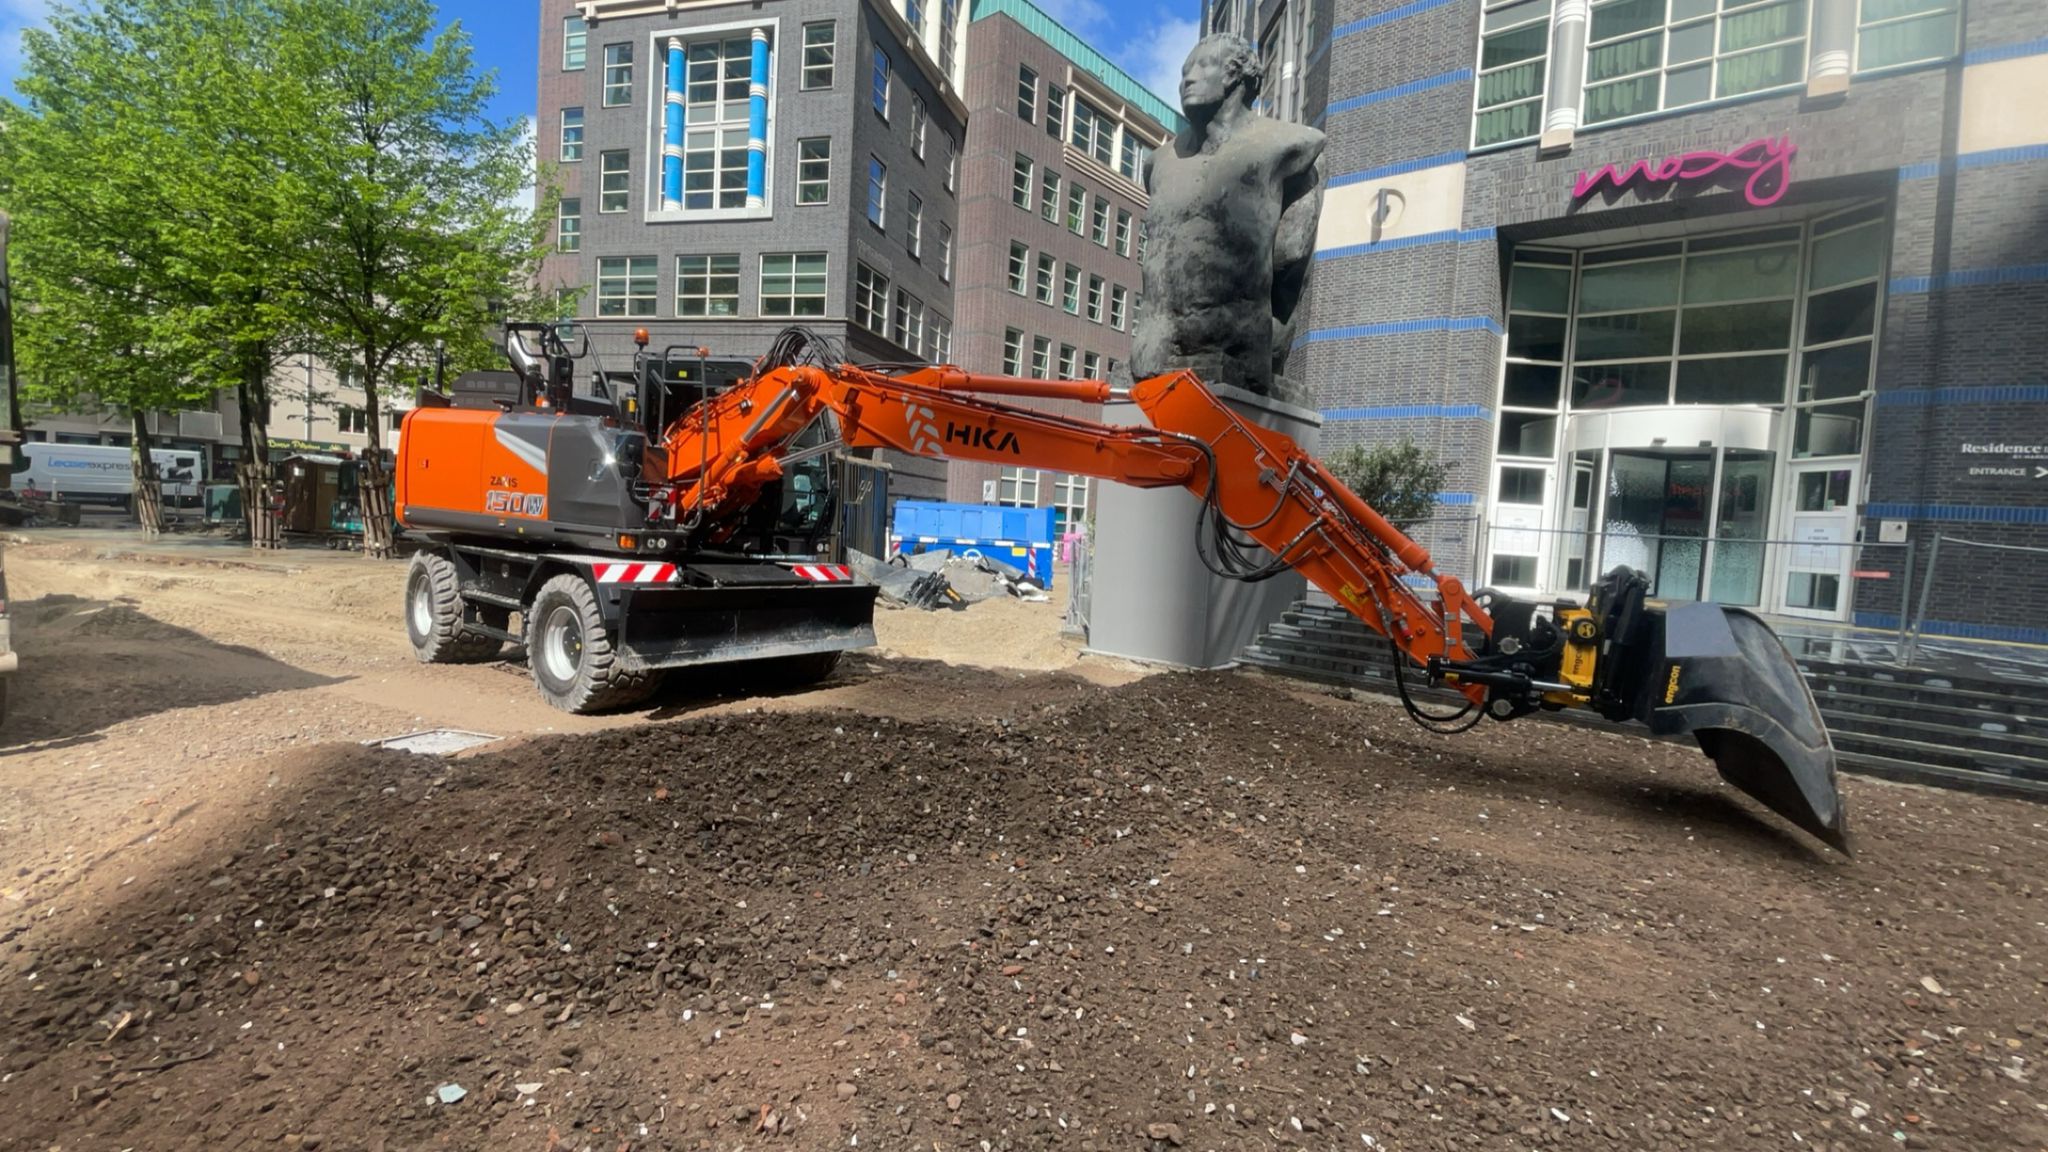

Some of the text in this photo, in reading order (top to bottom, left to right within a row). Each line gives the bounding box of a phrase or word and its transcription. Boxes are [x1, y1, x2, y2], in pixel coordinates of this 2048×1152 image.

[1573, 134, 1798, 206] moxy
[945, 421, 1020, 454] HKA
[1961, 443, 2041, 453] Residence
[486, 490, 545, 516] 150W
[1665, 665, 1681, 704] engcon
